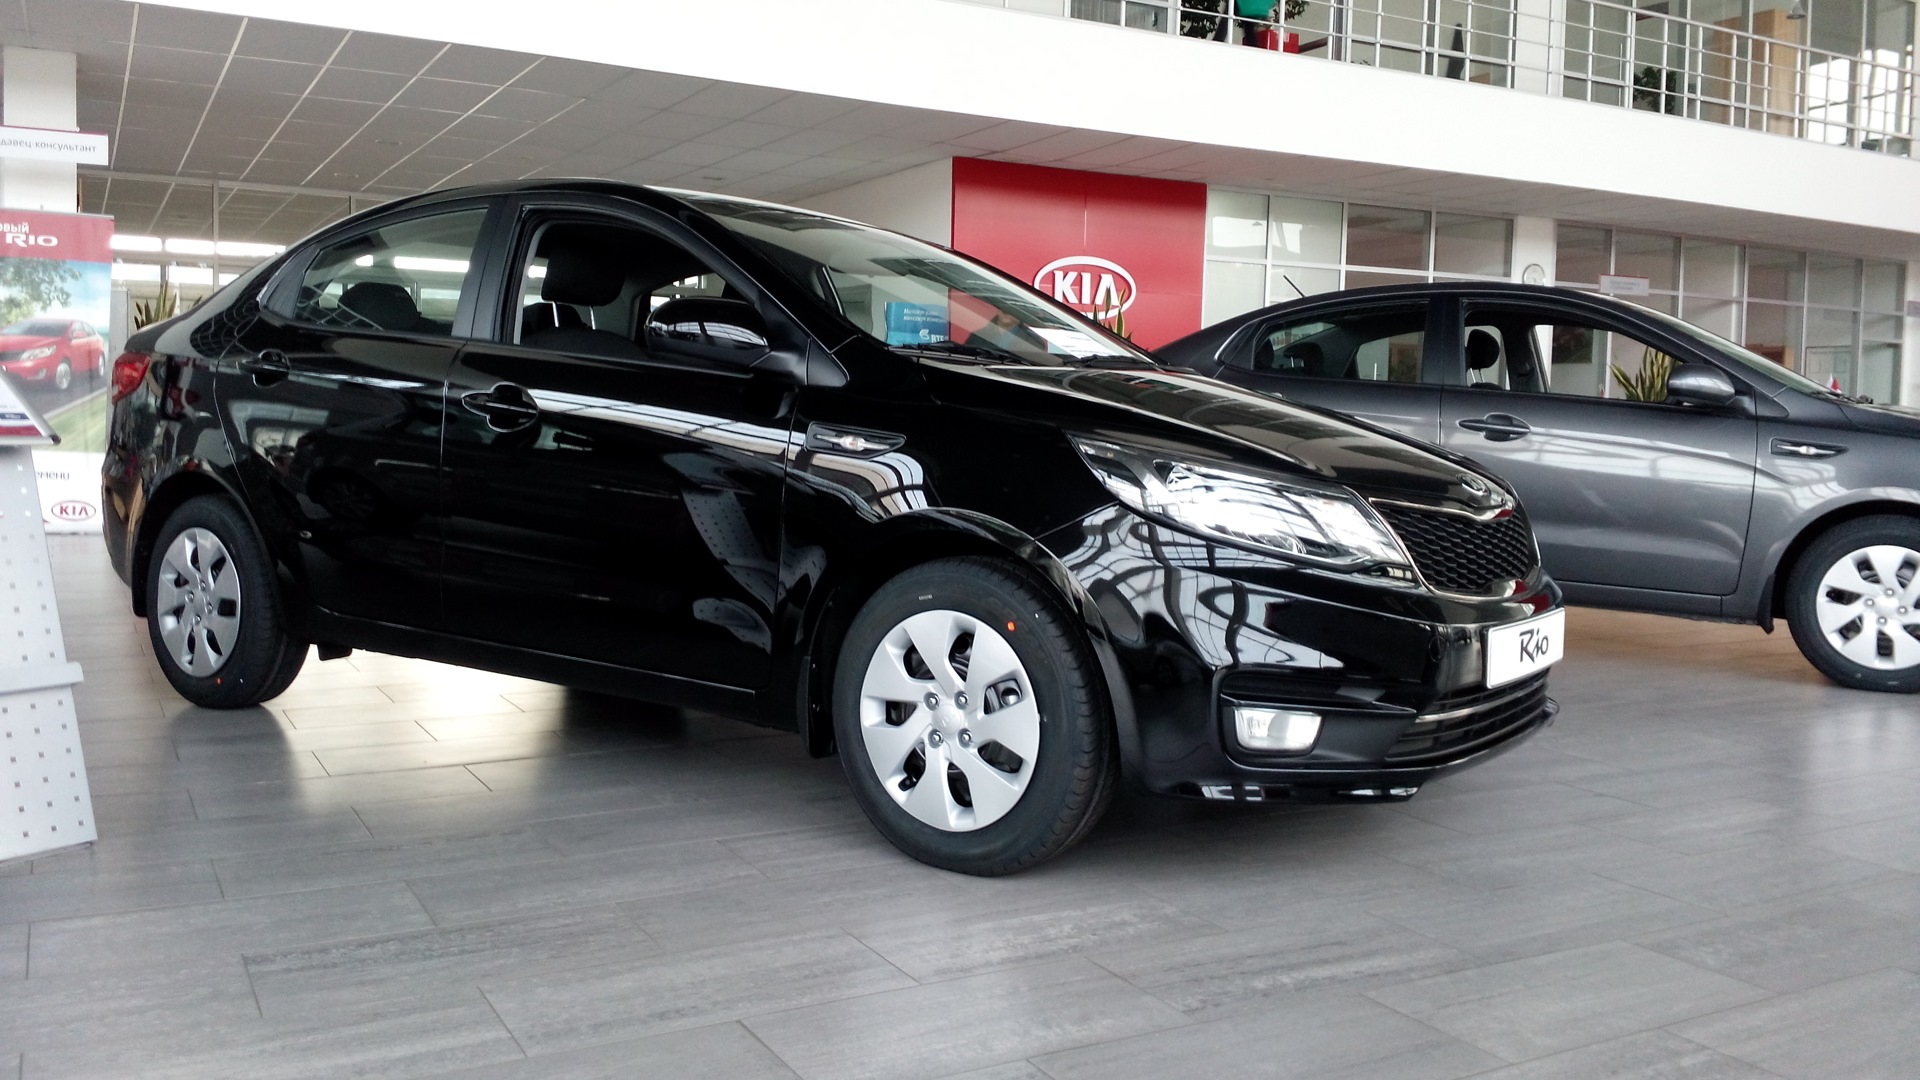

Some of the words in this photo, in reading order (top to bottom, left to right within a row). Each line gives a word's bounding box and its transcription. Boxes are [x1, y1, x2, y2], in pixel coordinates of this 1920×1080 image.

[1053, 270, 1121, 307] KIA
[59, 505, 90, 517] KIA
[1519, 627, 1550, 664] Rio
